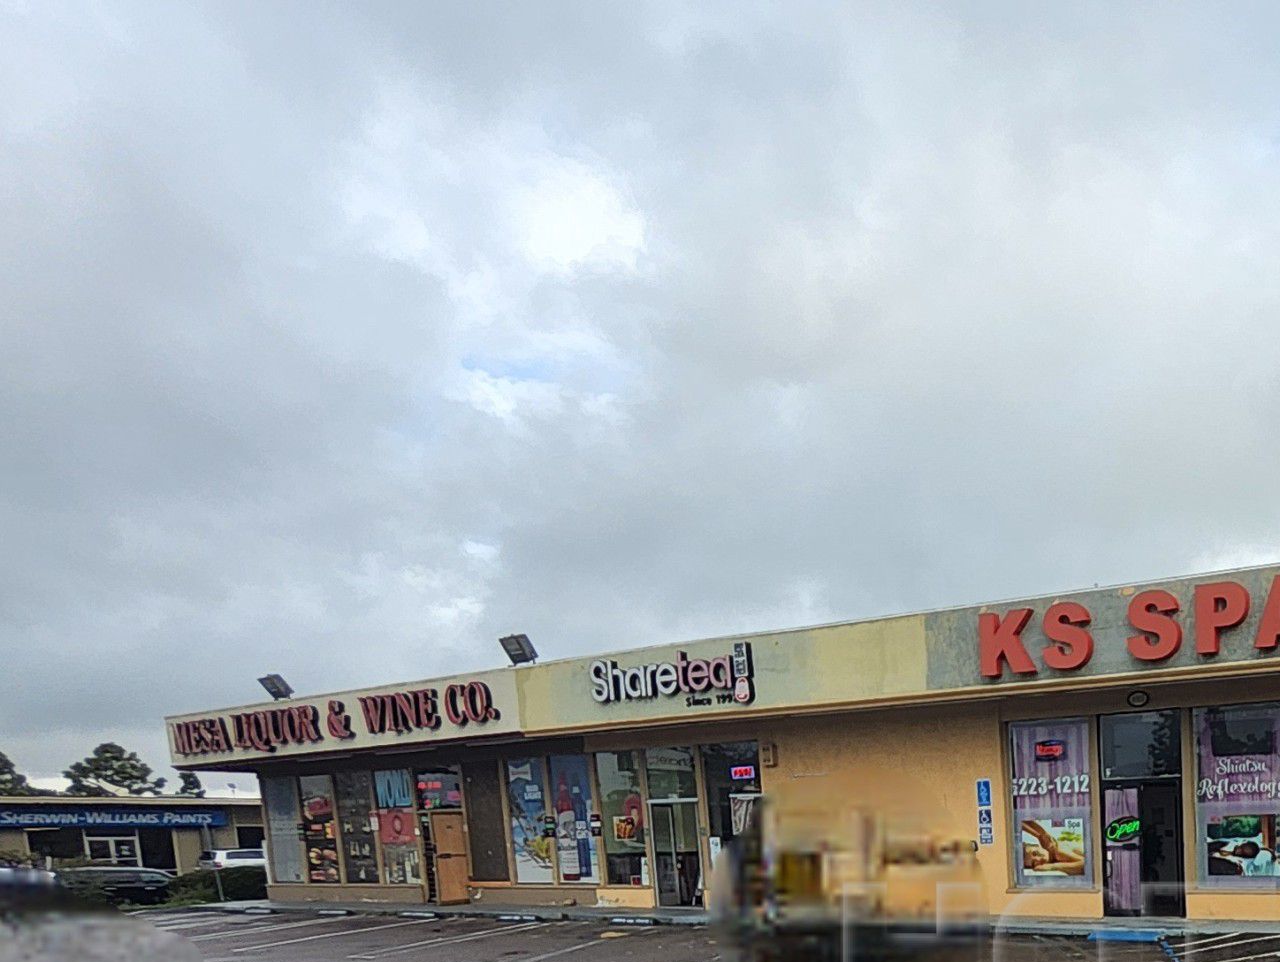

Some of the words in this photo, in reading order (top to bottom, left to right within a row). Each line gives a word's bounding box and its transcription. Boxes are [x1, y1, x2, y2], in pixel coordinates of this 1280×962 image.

[978, 602, 1094, 677] KS
[589, 650, 734, 703] Sharetea
[171, 717, 234, 756] MESA
[230, 705, 325, 753] LIQUOR
[327, 699, 356, 740] &
[357, 688, 441, 735] WINE
[445, 681, 500, 727] CO.
[1216, 758, 1270, 776] Shiatsu
[163, 812, 212, 824] PAINTS
[1107, 820, 1140, 839] Open
